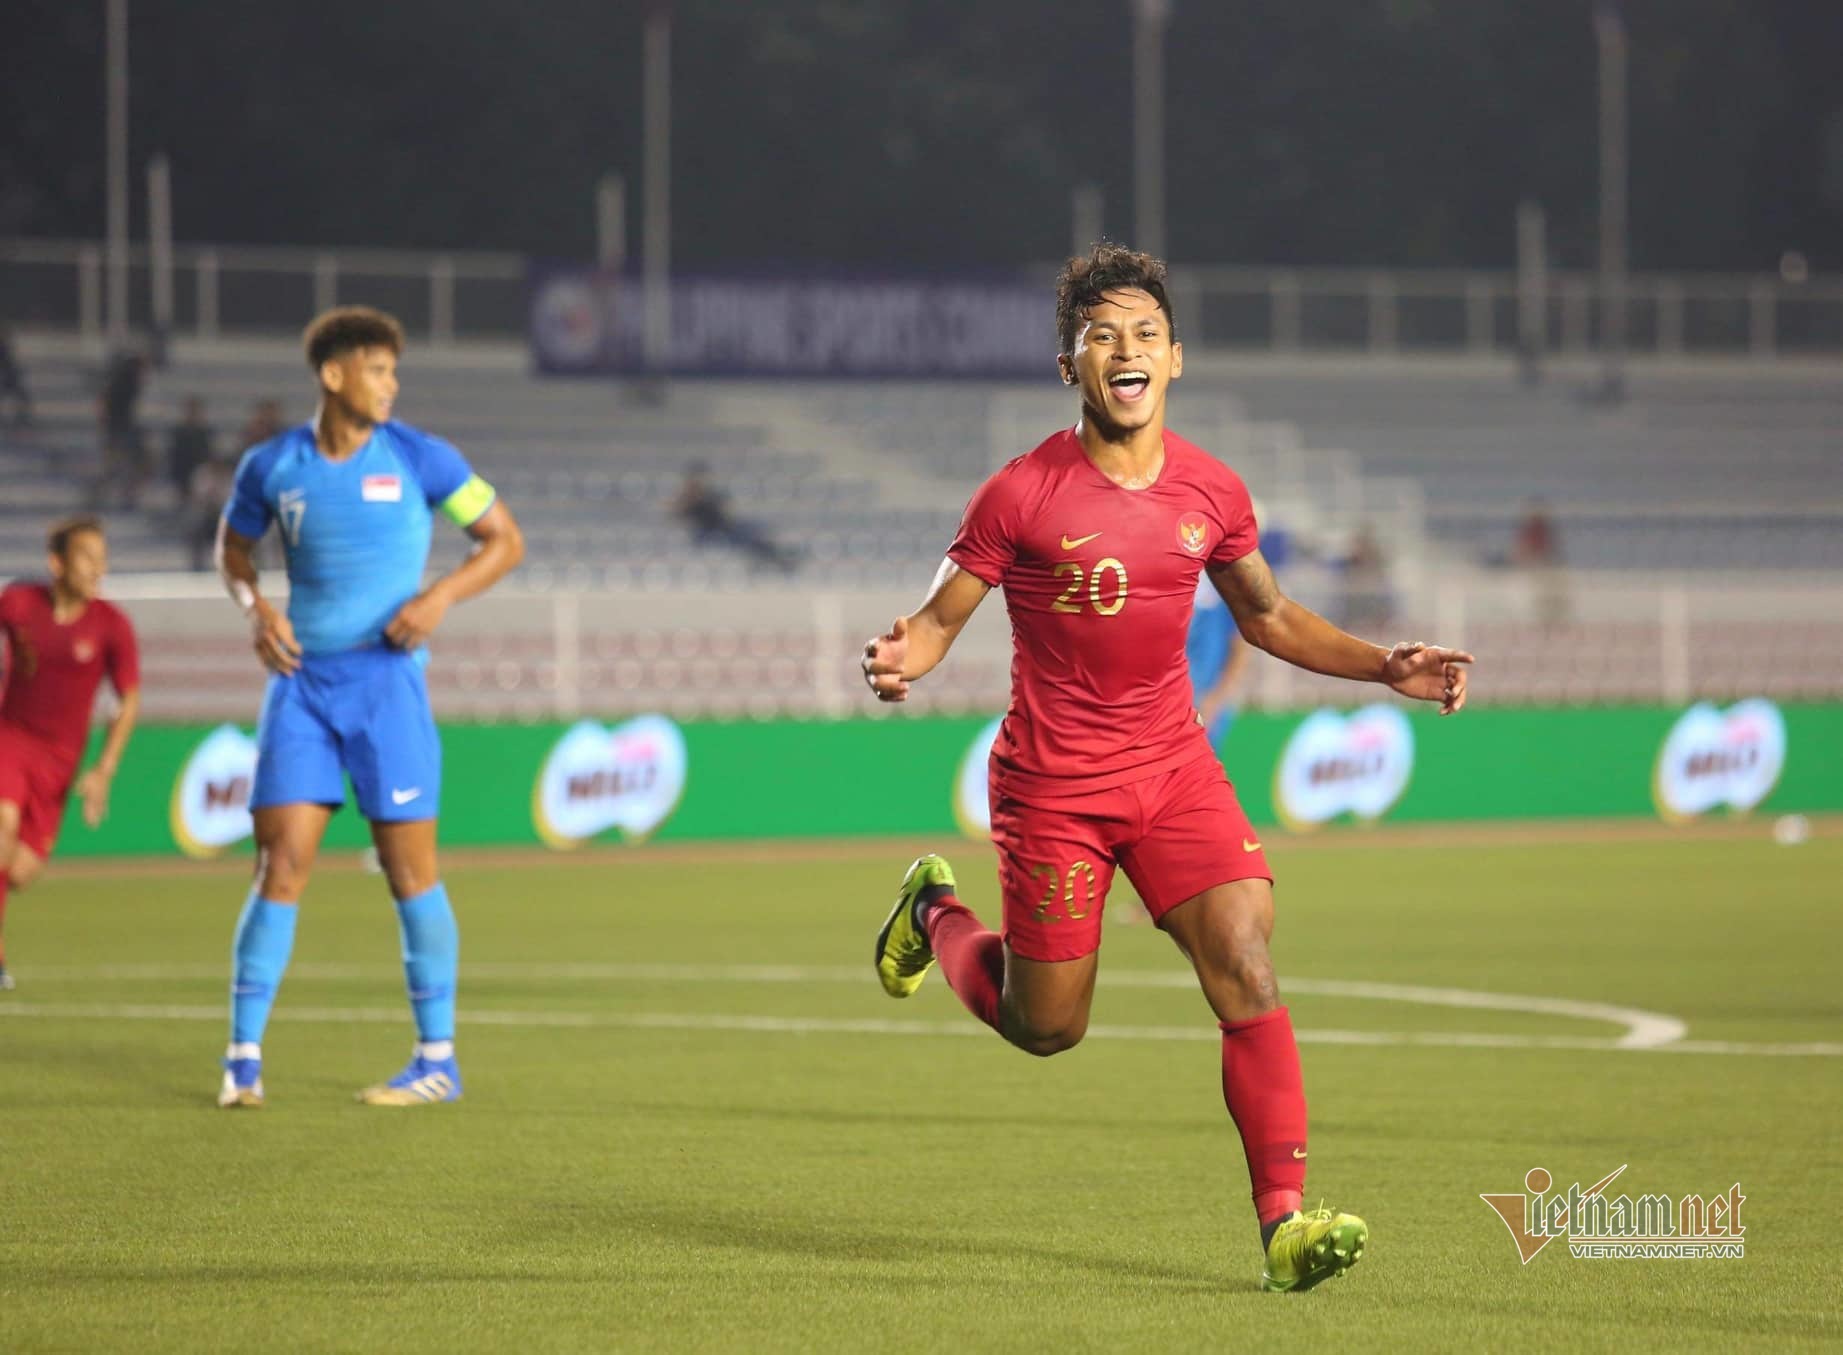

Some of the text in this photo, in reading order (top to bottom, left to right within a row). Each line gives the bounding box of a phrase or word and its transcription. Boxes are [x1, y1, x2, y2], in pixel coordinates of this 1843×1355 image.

[278, 488, 307, 546] 17
[1051, 558, 1127, 615] 20
[1030, 861, 1094, 924] 20
